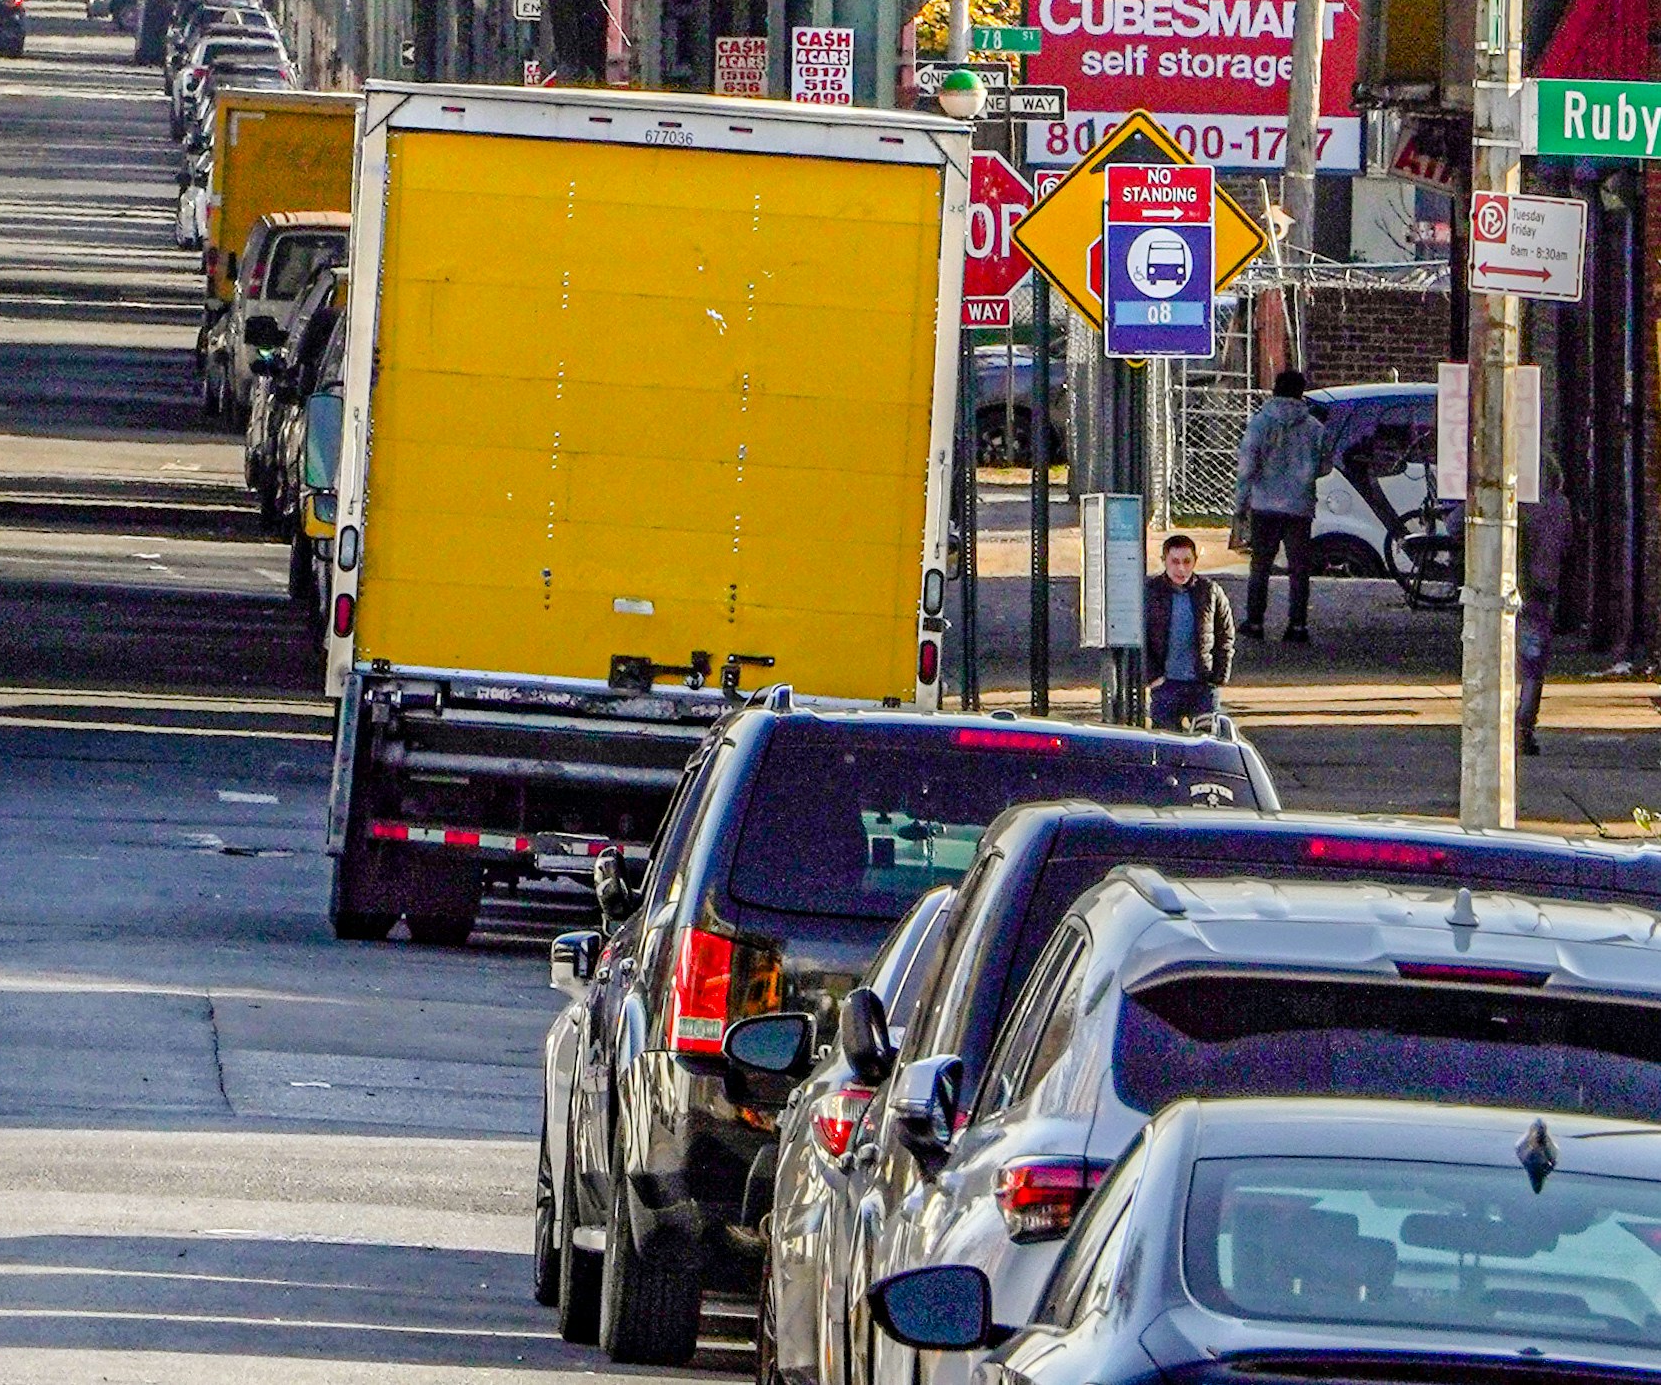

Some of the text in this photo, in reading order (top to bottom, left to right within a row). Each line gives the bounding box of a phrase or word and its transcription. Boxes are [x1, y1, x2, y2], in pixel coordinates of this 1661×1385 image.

[981, 31, 1003, 50] 78
[799, 67, 847, 78] (917)
[1080, 44, 1293, 88] self storage
[804, 79, 843, 91] 515
[795, 92, 850, 105] 6499
[984, 97, 1056, 111] NE WAY
[1563, 89, 1661, 156] Ruby
[645, 129, 694, 146] 677036
[1147, 168, 1172, 185] NO
[1122, 186, 1198, 204] STANDING
[1512, 208, 1546, 226] Tuesday
[1511, 222, 1537, 240] Friday
[967, 302, 1004, 322] WAY
[1147, 301, 1172, 324] Q8
